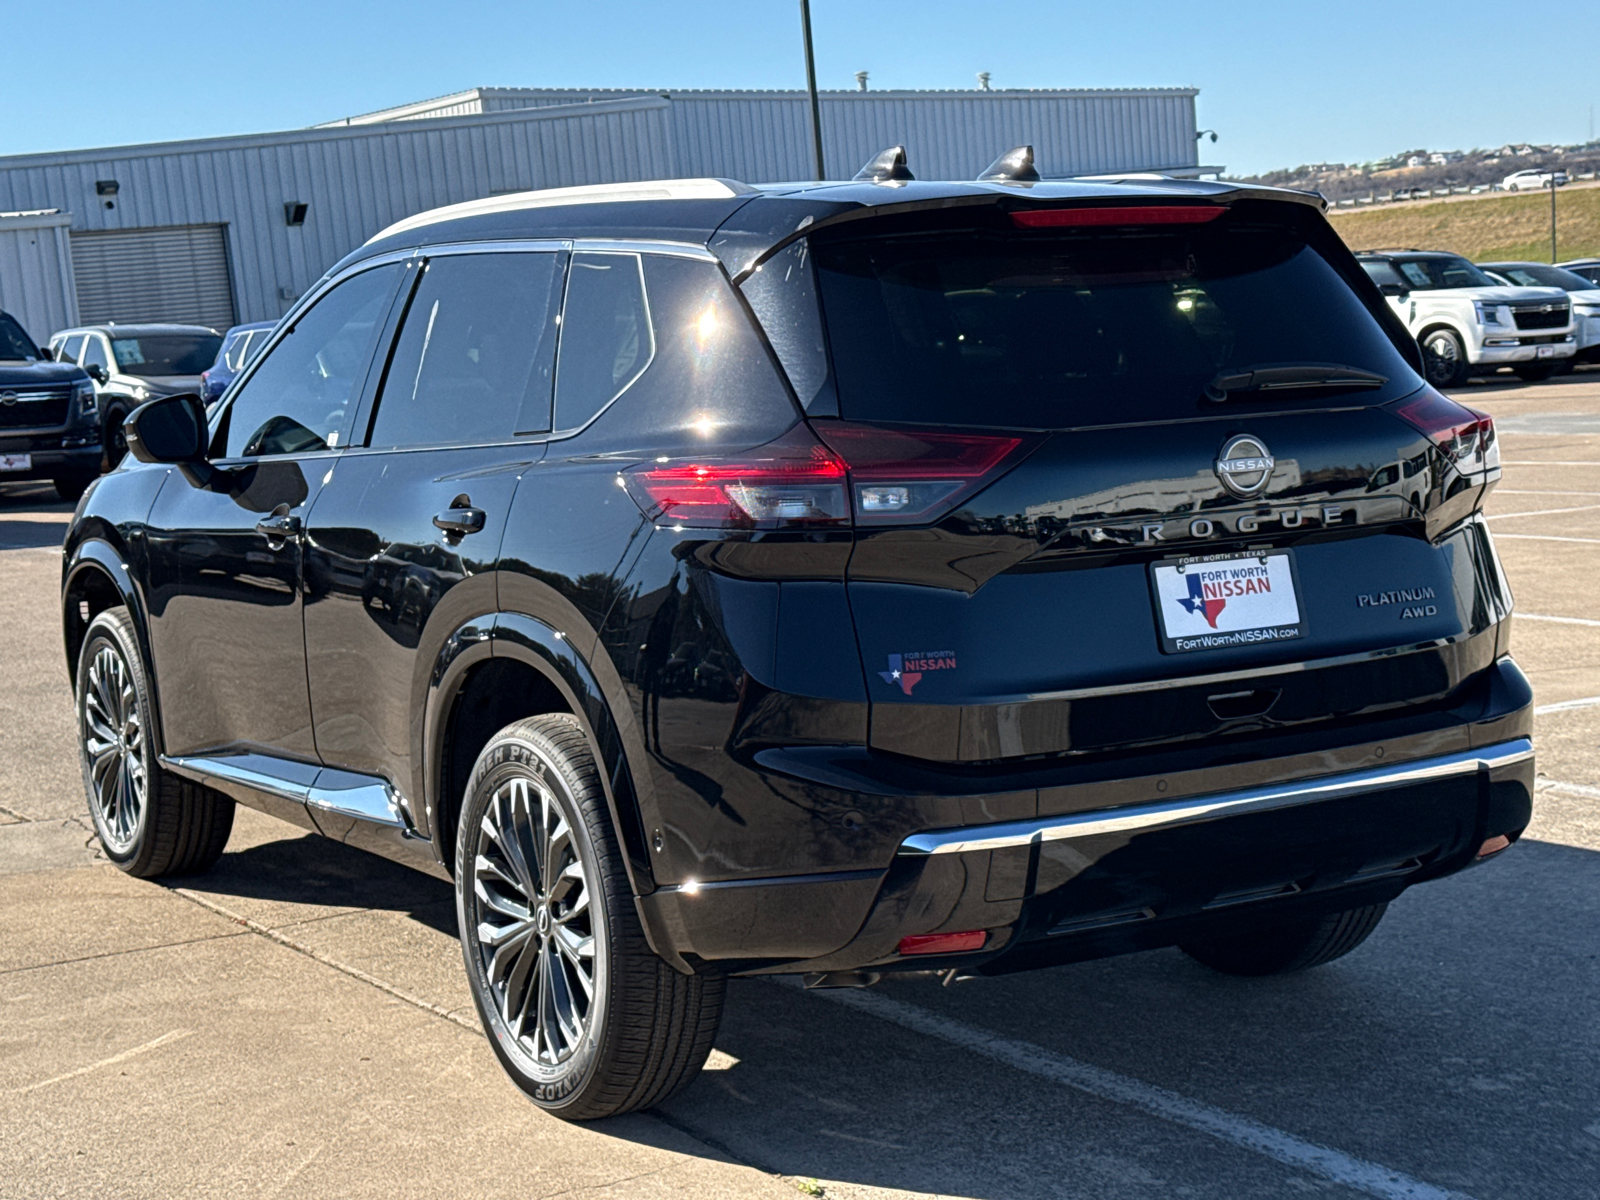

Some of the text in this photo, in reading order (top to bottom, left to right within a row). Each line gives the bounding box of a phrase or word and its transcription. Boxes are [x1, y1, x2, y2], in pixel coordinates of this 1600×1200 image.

[1219, 458, 1274, 472] NISSAN
[1143, 506, 1343, 541] ROGUE
[1179, 550, 1266, 565] FORT WORTH TEXAS
[1201, 566, 1268, 582] FORT WORTH
[1203, 577, 1271, 600] NISSAN
[1357, 586, 1435, 607] PLATINUM
[1402, 604, 1437, 619] AWD
[904, 650, 955, 660] FORT WORTH
[905, 658, 957, 671] NISSAN
[509, 745, 547, 779] PT21
